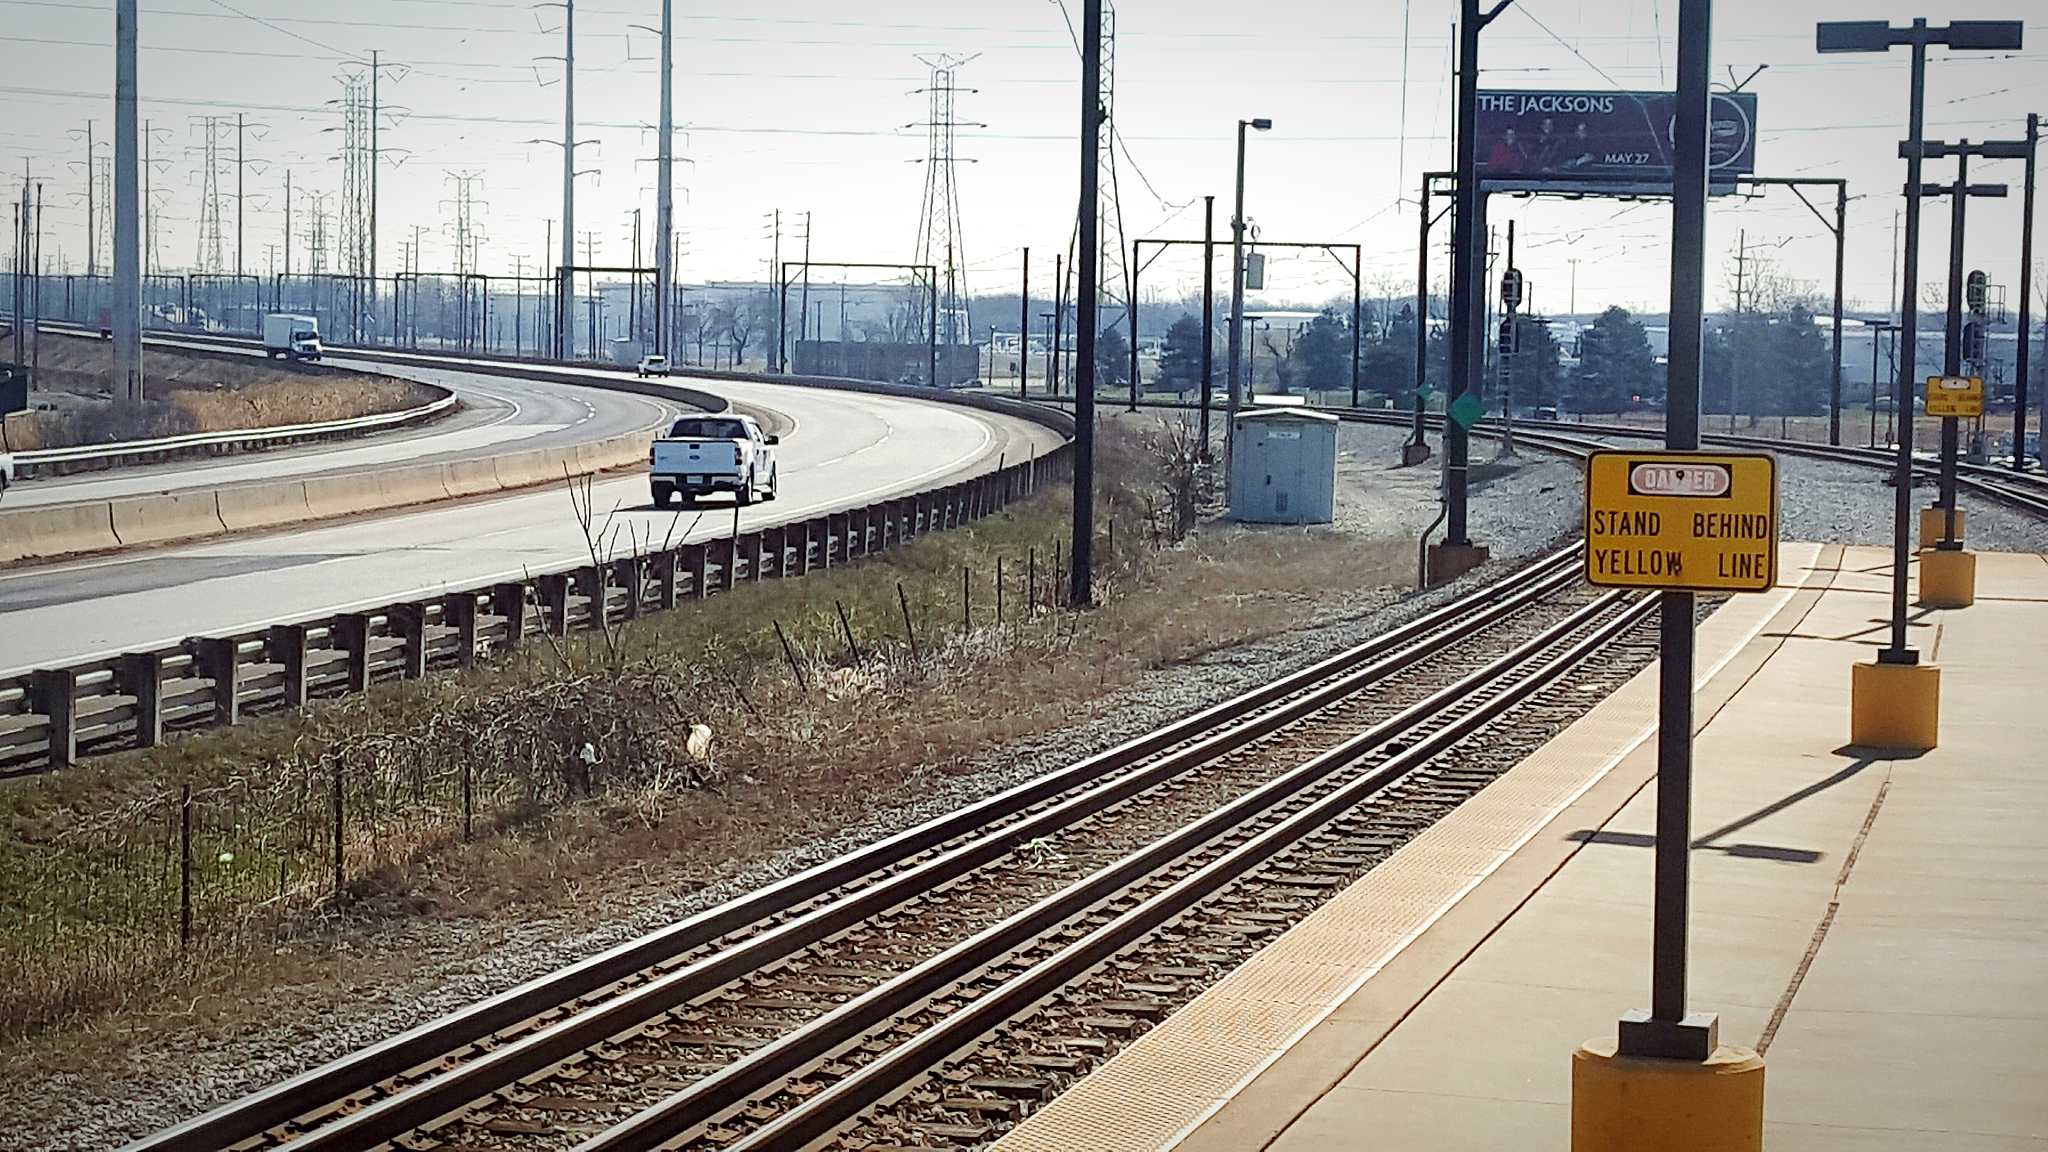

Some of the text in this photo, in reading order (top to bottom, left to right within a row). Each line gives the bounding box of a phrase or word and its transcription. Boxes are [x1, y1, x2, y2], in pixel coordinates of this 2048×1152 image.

[1478, 95, 1614, 115] THE JACKSONS
[1604, 153, 1649, 163] MAY 27
[1594, 510, 1767, 539] STAND BEHIND
[1594, 549, 1765, 578] YELLOW LINE
